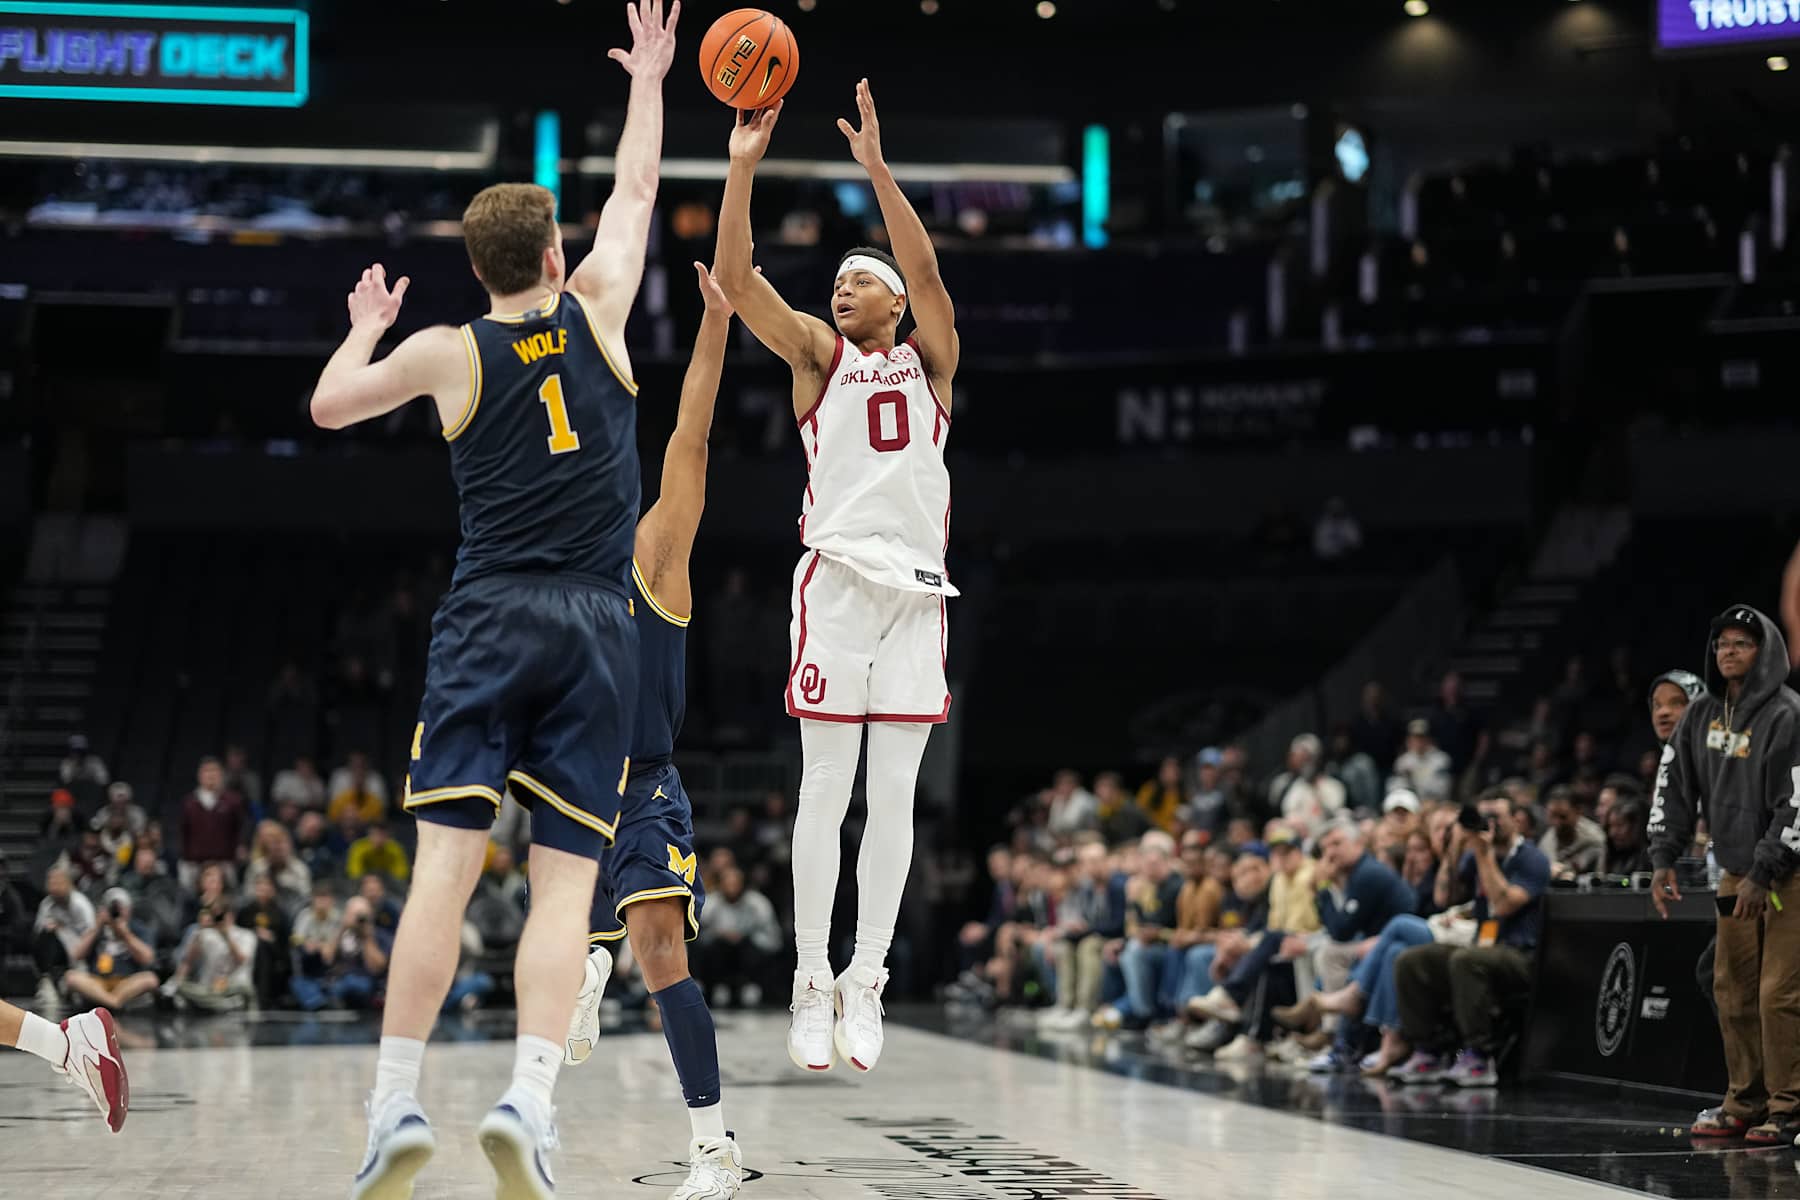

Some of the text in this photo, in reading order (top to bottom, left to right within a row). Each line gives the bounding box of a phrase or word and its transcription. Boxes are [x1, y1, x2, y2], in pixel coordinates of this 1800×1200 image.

[1690, 0, 1800, 30] TRUIST
[0, 28, 287, 78] FLIGHT DECK
[718, 36, 758, 88] ELITE
[512, 328, 567, 365] WOLF
[840, 367, 920, 387] OKLAHOMA
[538, 373, 580, 455] 1
[866, 390, 911, 453] 0
[800, 663, 827, 704] OU
[666, 842, 698, 886] M
